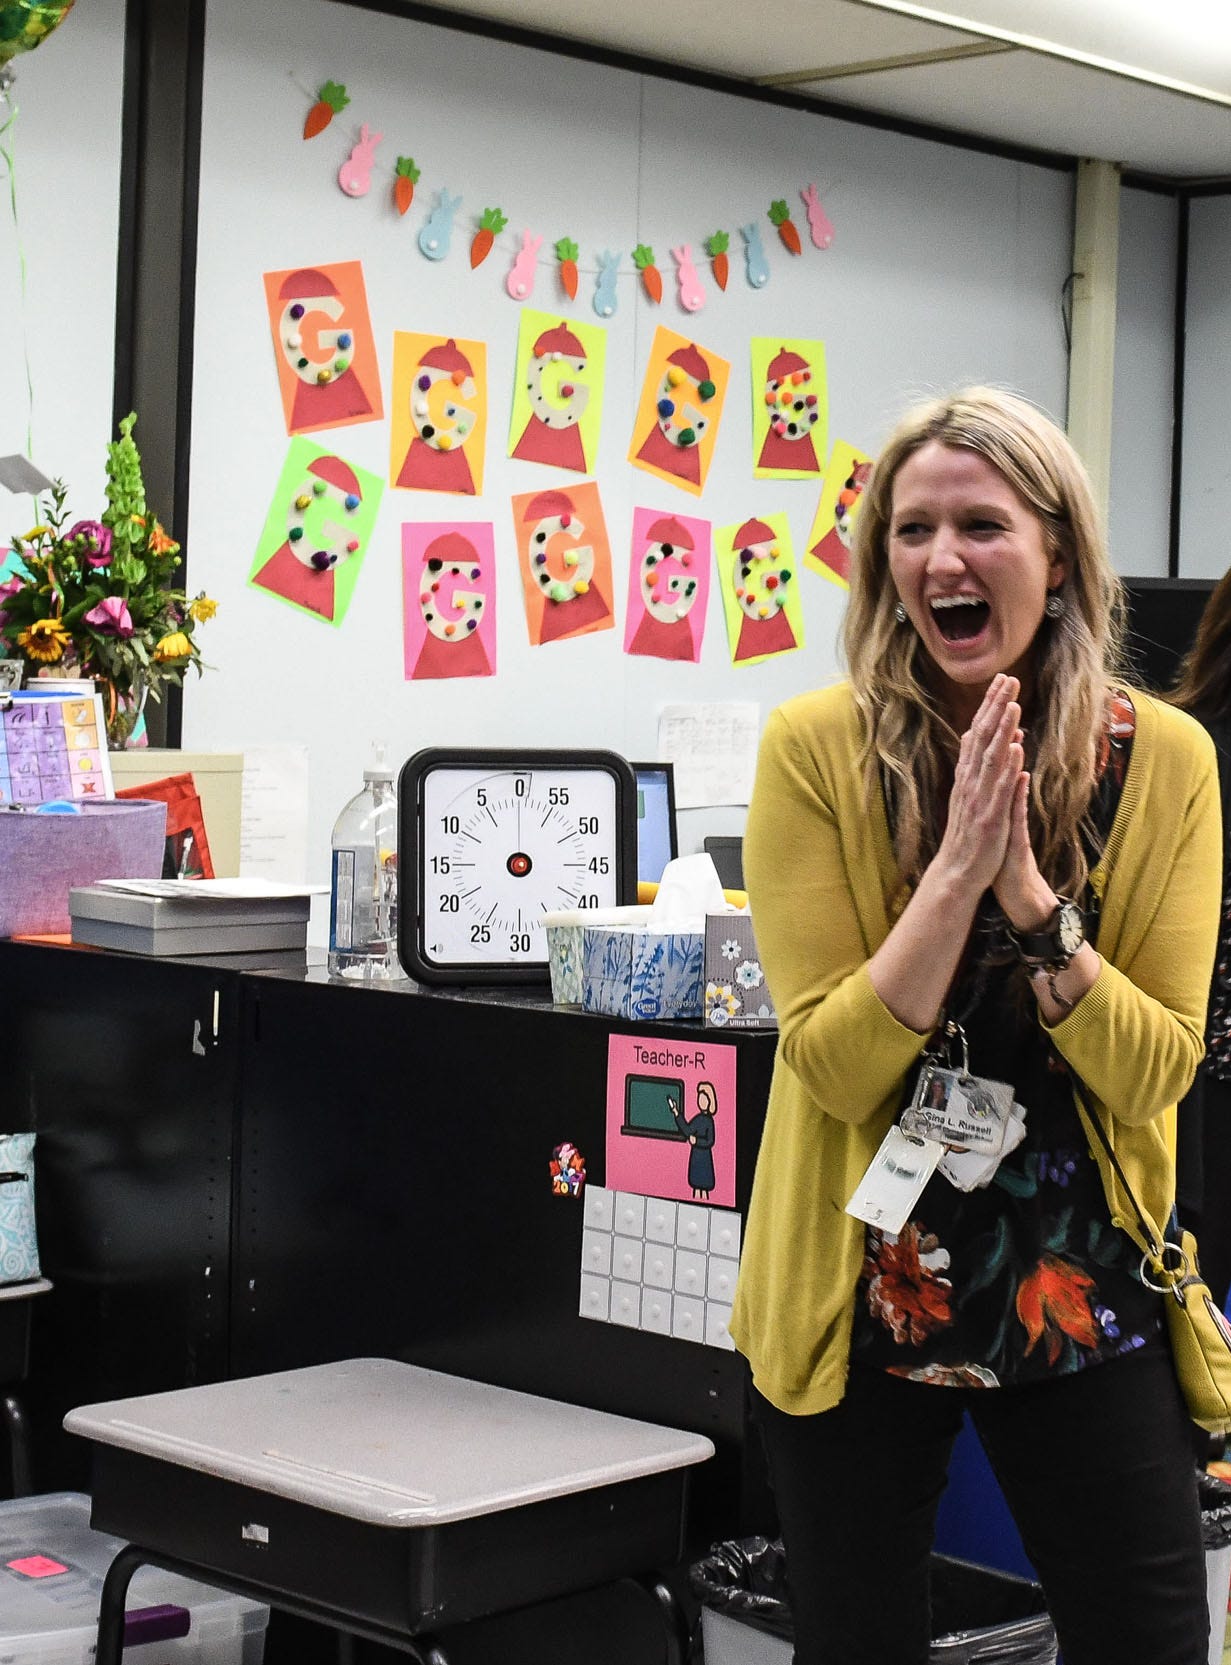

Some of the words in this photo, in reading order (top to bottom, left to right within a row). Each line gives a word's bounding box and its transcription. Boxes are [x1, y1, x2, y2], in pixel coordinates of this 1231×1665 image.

[515, 779, 525, 797] 0
[549, 788, 569, 805] 55
[477, 789, 487, 806] 5
[441, 816, 460, 834] 10
[579, 817, 599, 835] 50
[430, 857, 450, 874] 15
[588, 857, 609, 874] 45
[440, 895, 460, 913] 20
[578, 895, 599, 909] 40
[470, 925, 491, 943] 25
[510, 935, 530, 952] 30
[729, 1019, 745, 1027] Ultra
[634, 1046, 705, 1069] Teacher-R
[925, 1111, 945, 1124] Gina
[958, 1120, 992, 1135] Russell
[553, 1181, 580, 1196] 2017
